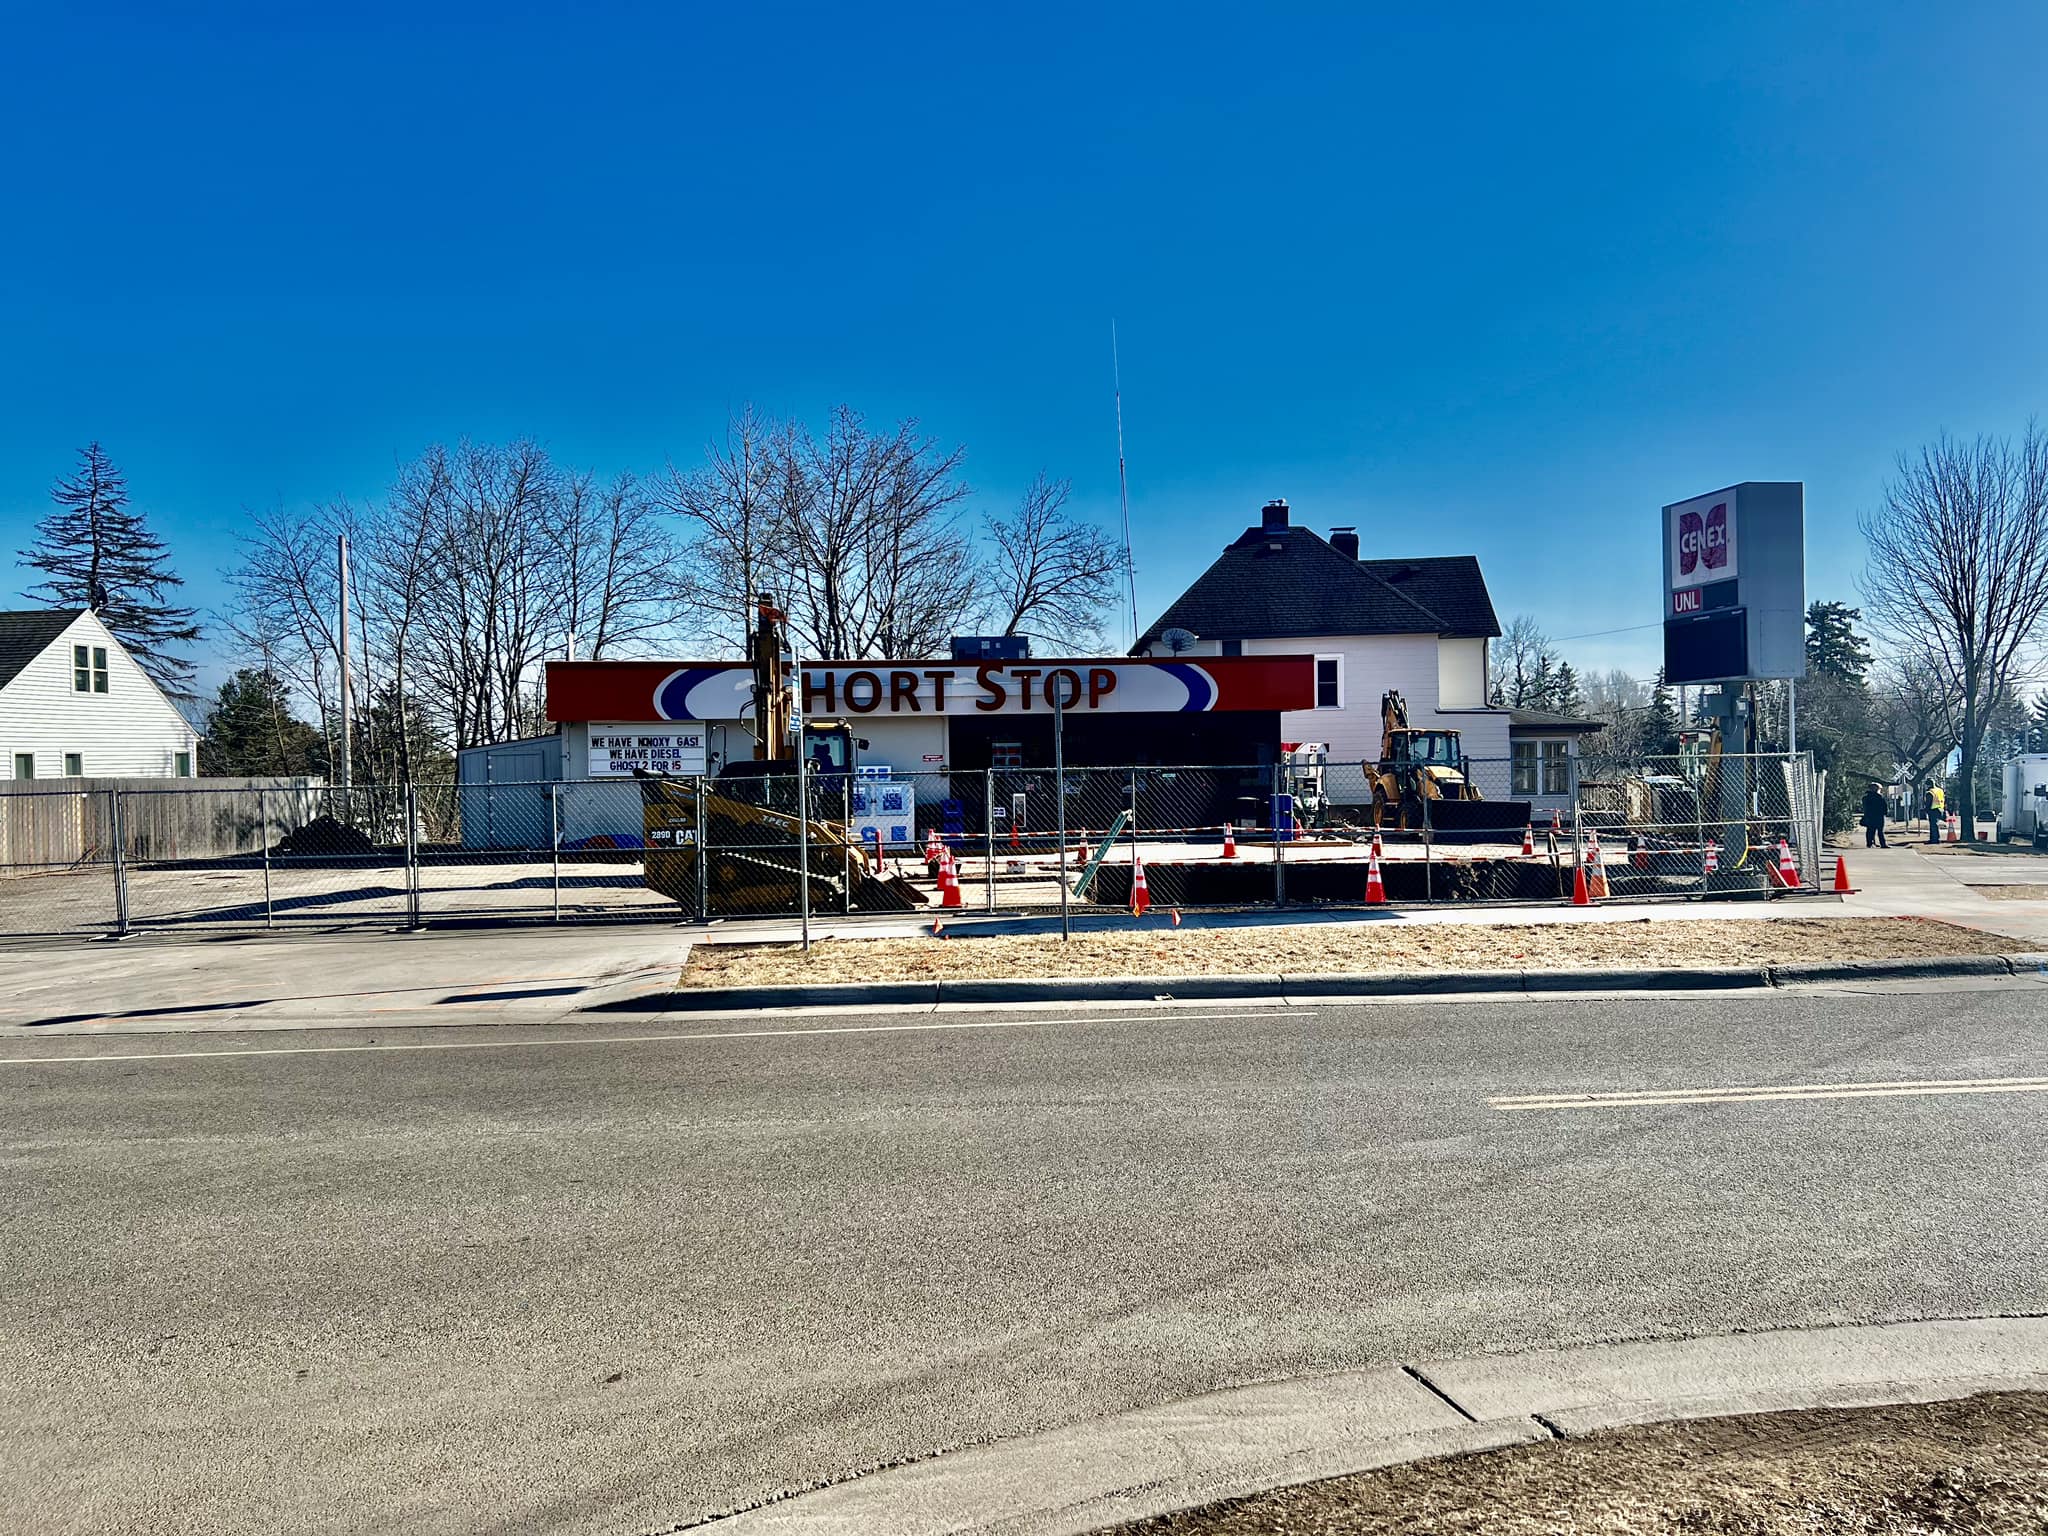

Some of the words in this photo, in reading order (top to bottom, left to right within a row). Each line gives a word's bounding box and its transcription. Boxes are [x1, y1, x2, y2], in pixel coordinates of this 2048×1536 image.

[1681, 524, 1725, 553] CENEX
[1675, 591, 1699, 612] UNL
[781, 664, 954, 713] HORT
[976, 664, 1117, 711] STOP
[592, 737, 606, 747] WE
[608, 737, 632, 747] HAVE
[677, 736, 699, 746] GAS!
[610, 749, 622, 759] WE
[625, 749, 648, 759] HAVE
[651, 748, 681, 759] DIESEL
[610, 760, 639, 771] GHOST
[642, 760, 648, 770] 2
[652, 760, 669, 770] FOR
